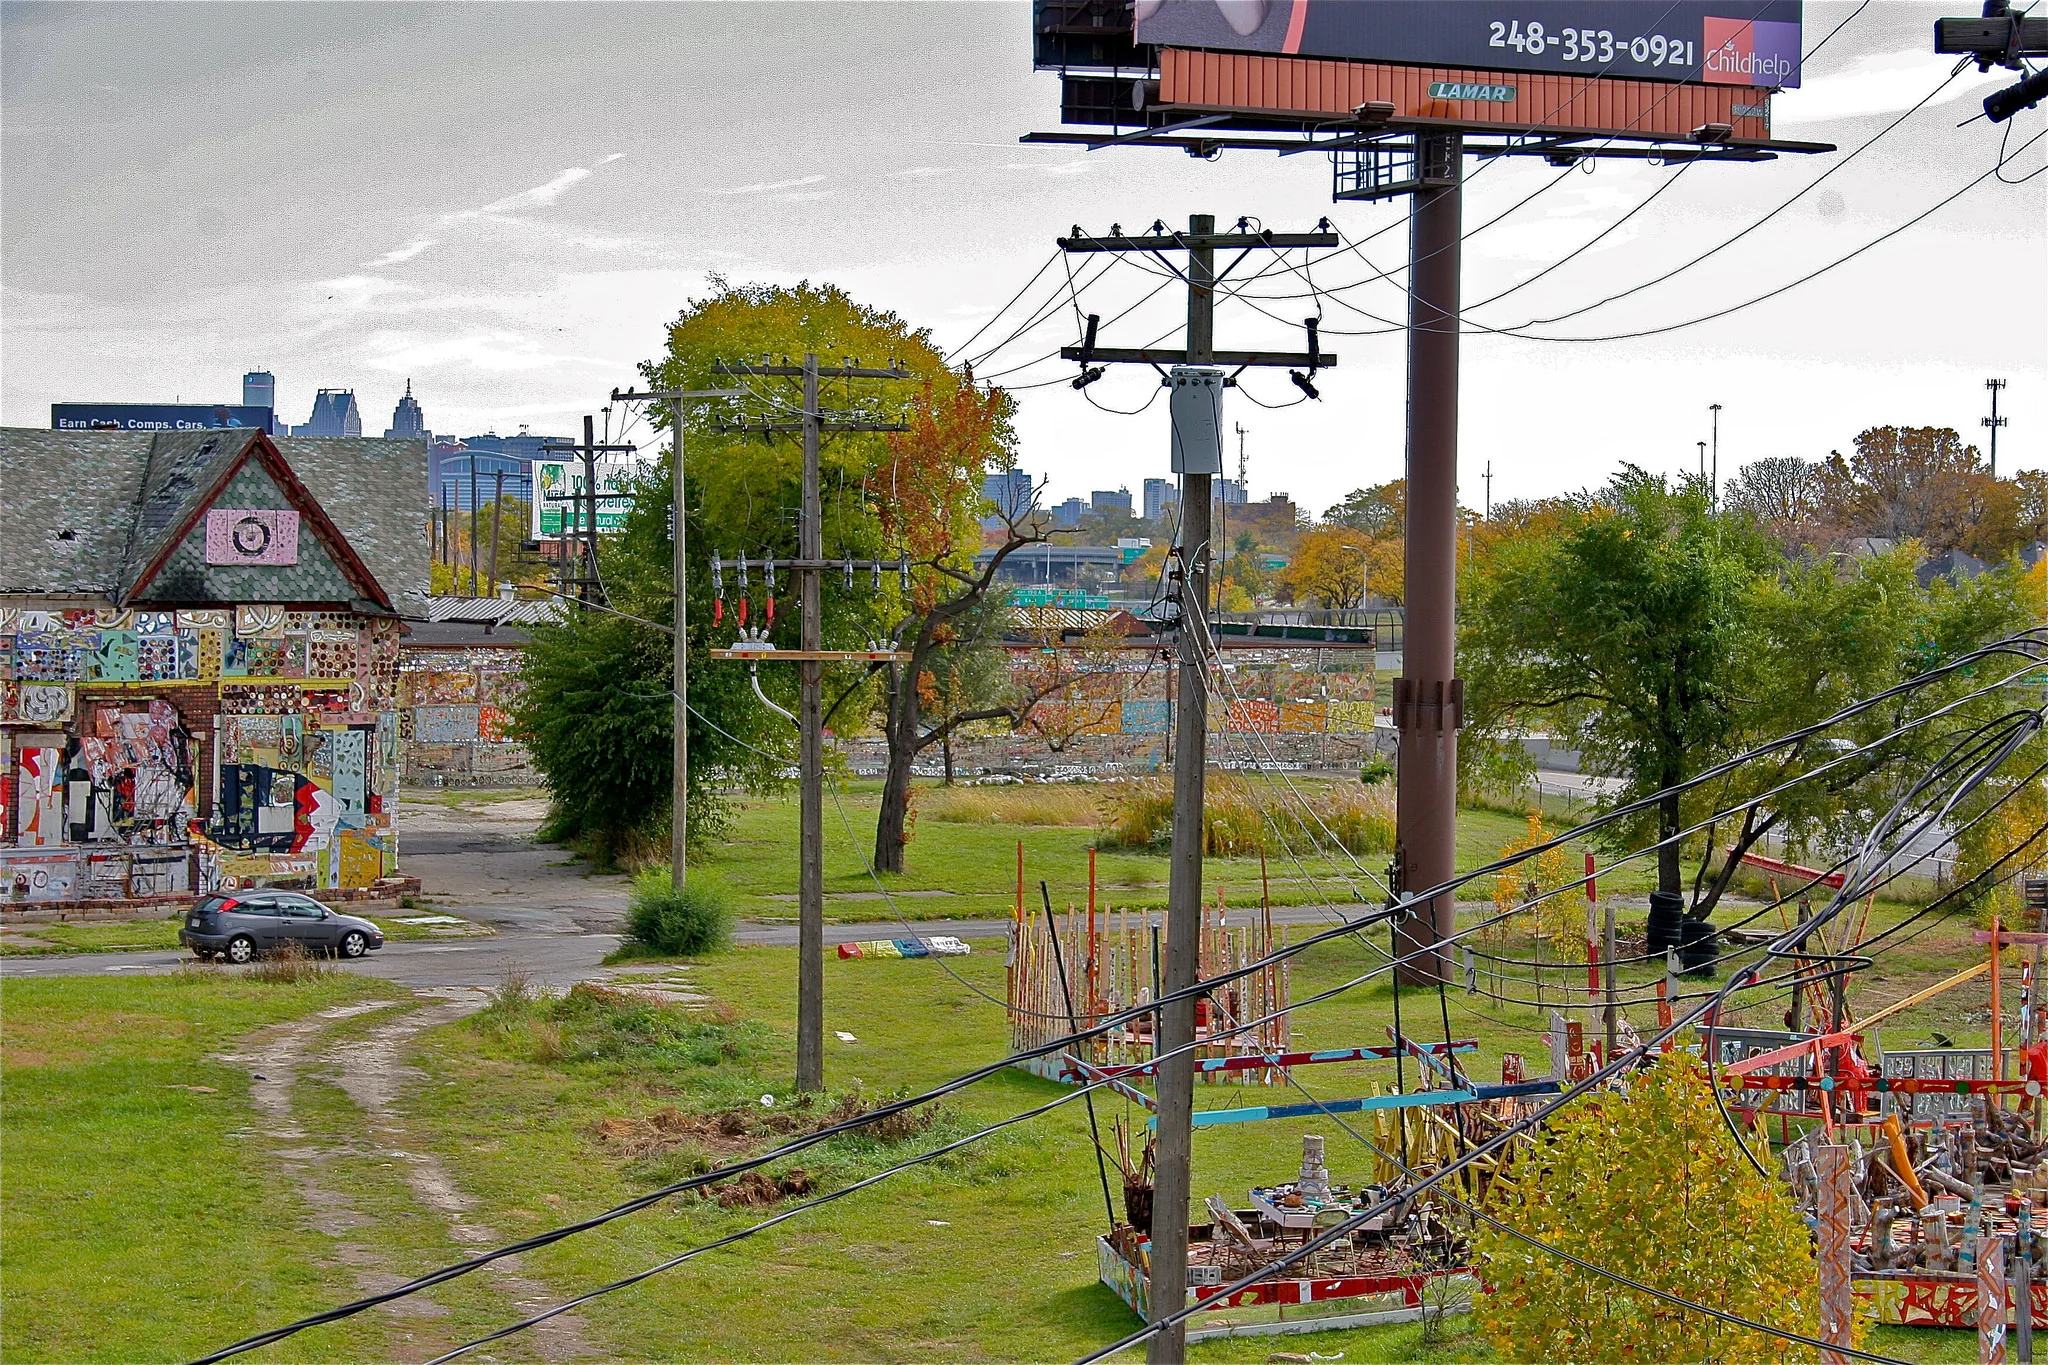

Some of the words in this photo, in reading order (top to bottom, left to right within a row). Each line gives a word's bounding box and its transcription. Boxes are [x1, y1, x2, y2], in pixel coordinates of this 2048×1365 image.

[1489, 20, 1693, 67] 248-353-0921
[1706, 50, 1791, 83] Childhelp
[1436, 83, 1507, 100] LAMAR
[59, 417, 87, 428] Earn
[128, 419, 173, 431] Comps.
